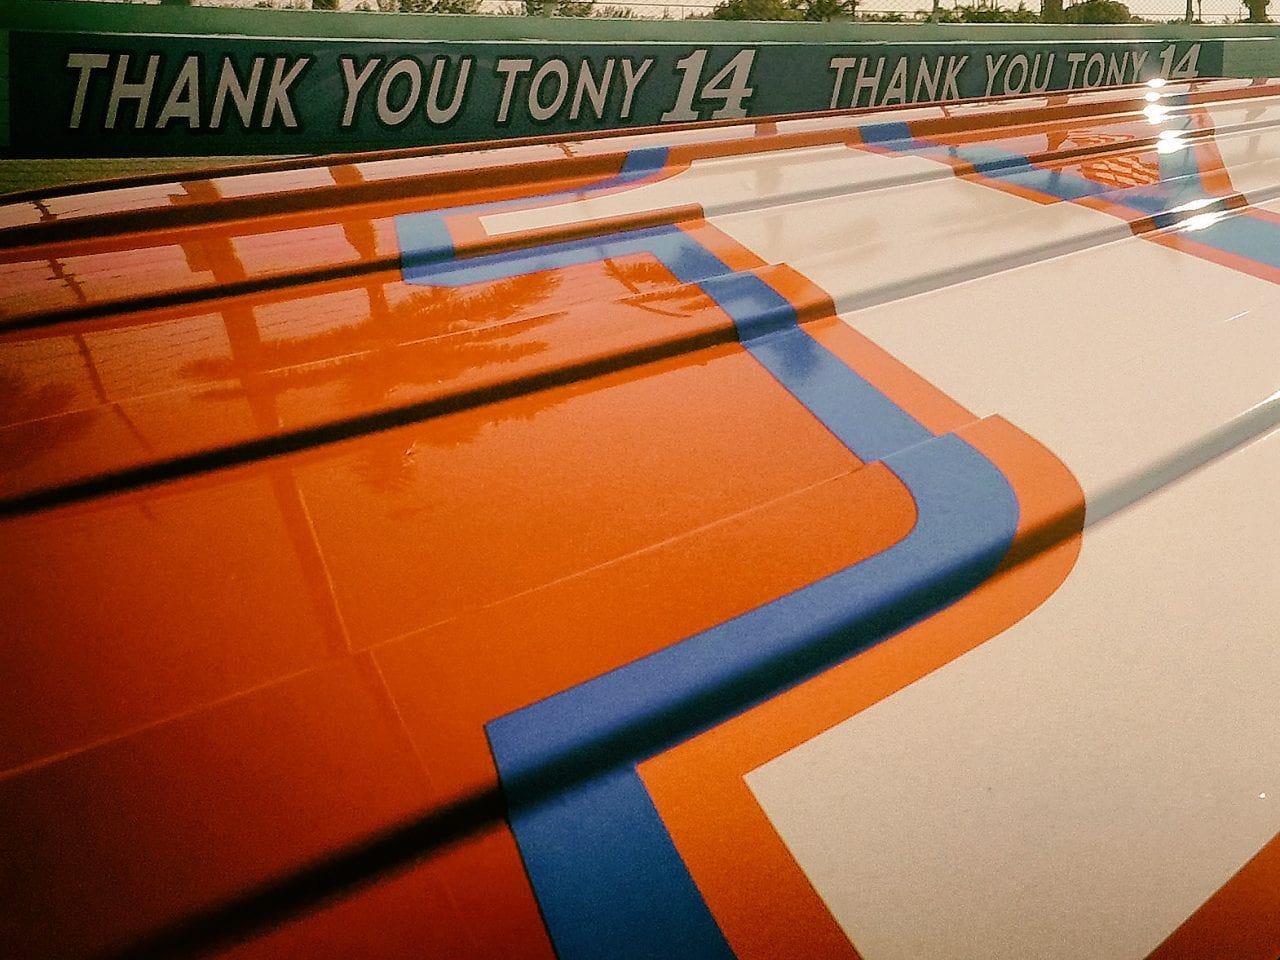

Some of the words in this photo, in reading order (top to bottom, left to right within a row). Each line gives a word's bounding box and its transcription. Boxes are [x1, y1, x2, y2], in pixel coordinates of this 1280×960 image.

[67, 53, 309, 129] THANK
[341, 58, 472, 126] YOU
[497, 58, 653, 122] TONY
[660, 48, 755, 122] 14
[830, 54, 969, 109] THANK
[986, 53, 1054, 98] YOU
[1068, 49, 1150, 90] TONY
[1160, 43, 1202, 81] 14
